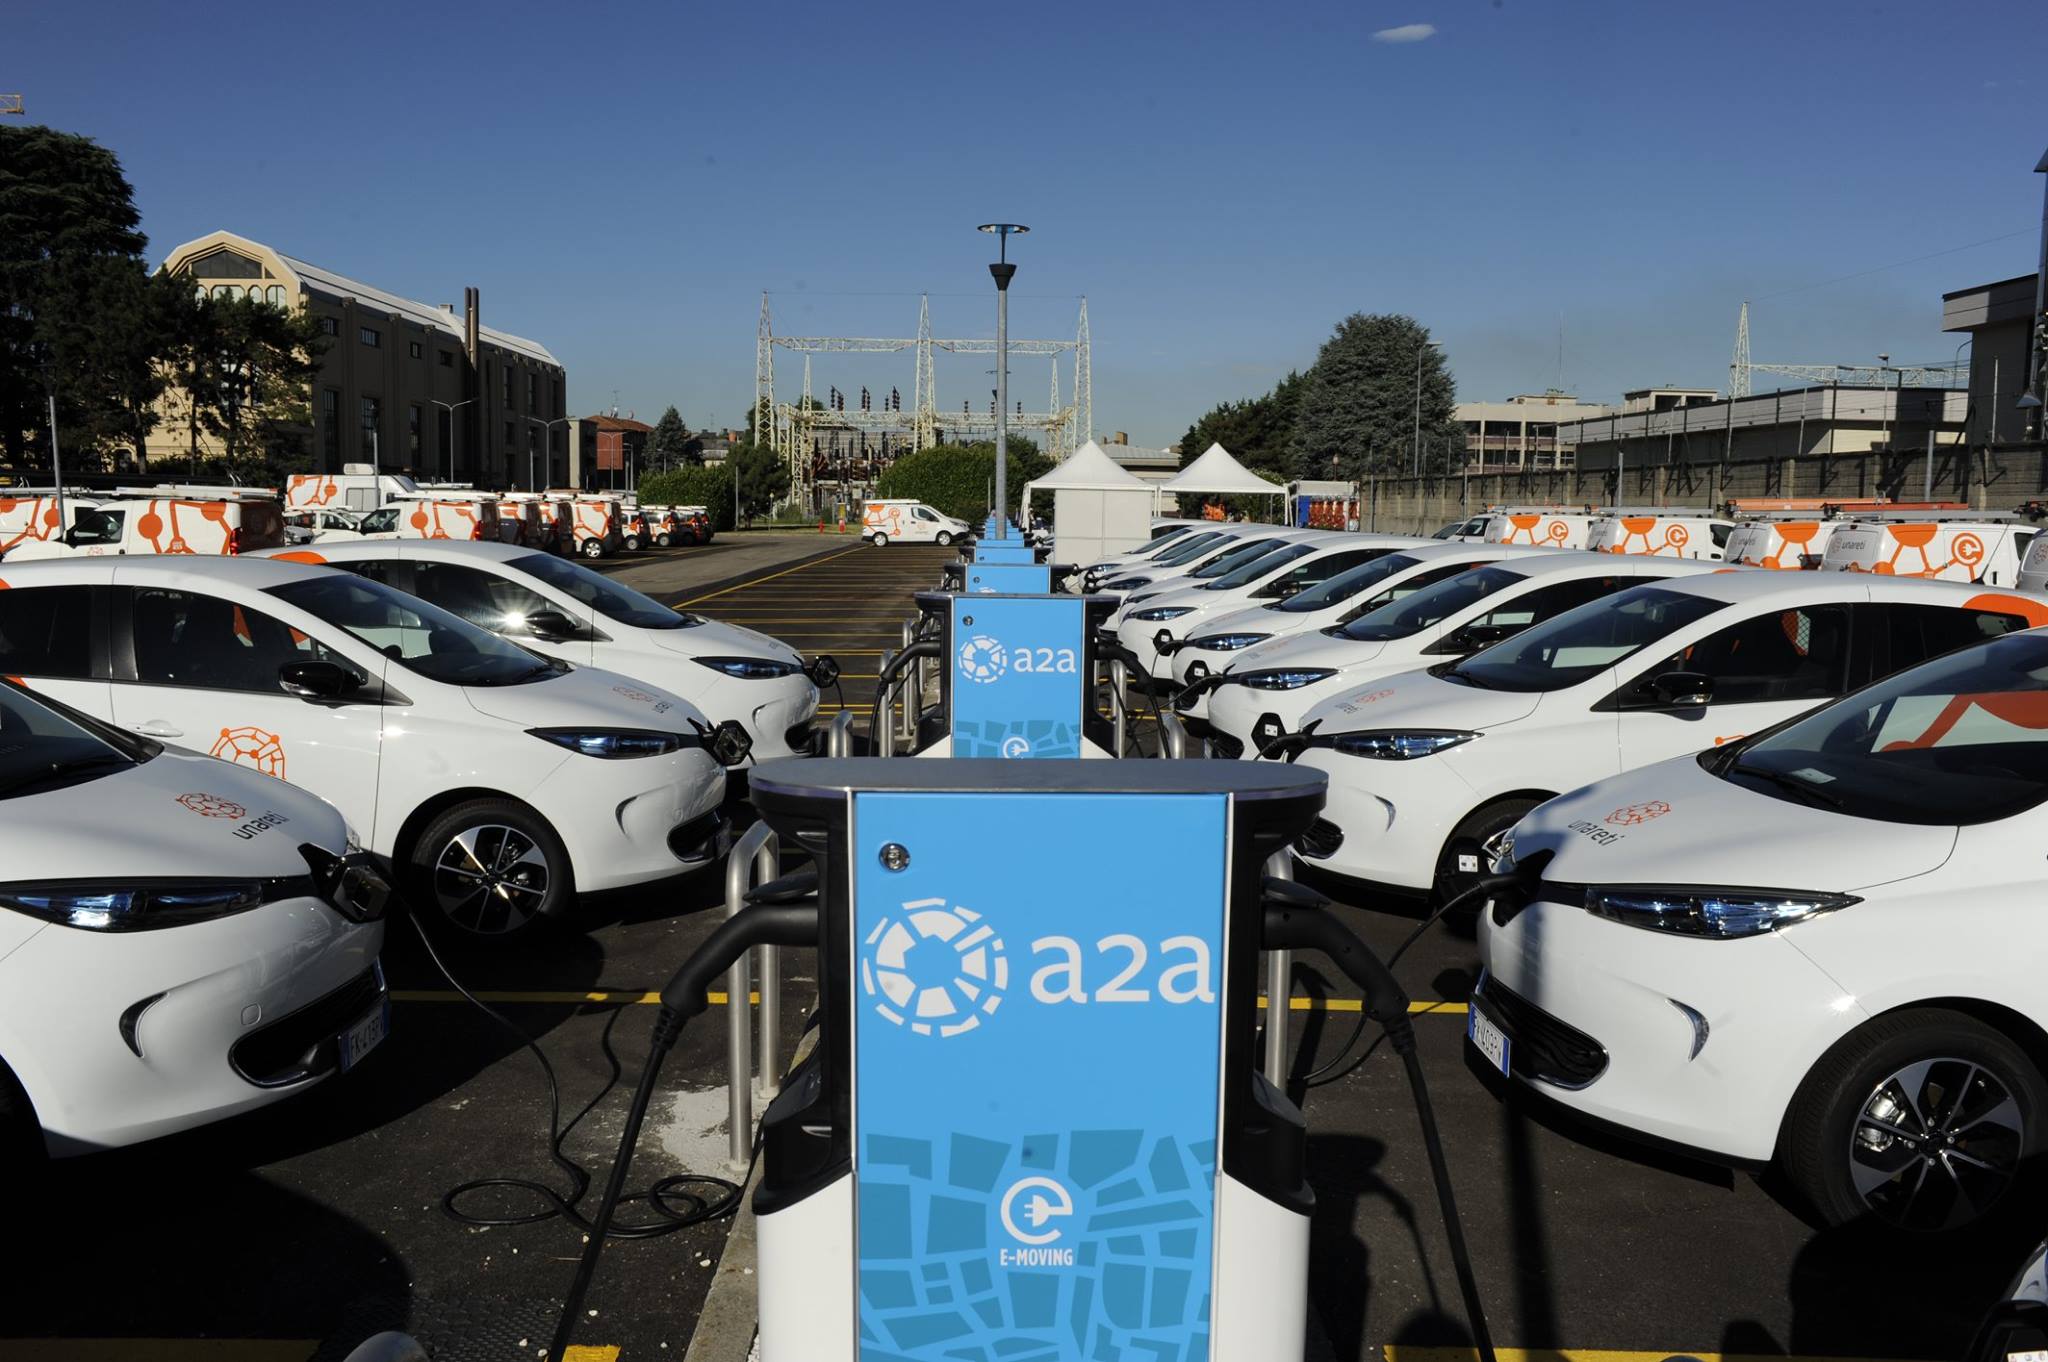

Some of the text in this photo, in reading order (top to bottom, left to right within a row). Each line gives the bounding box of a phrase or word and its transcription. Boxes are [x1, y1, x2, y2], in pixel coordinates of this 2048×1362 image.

[1014, 647, 1076, 673] a2a
[231, 810, 291, 840] unareti
[1567, 819, 1625, 846] unareti
[1030, 934, 1215, 1004] a2a
[1000, 1249, 1073, 1266] E-MOVING
